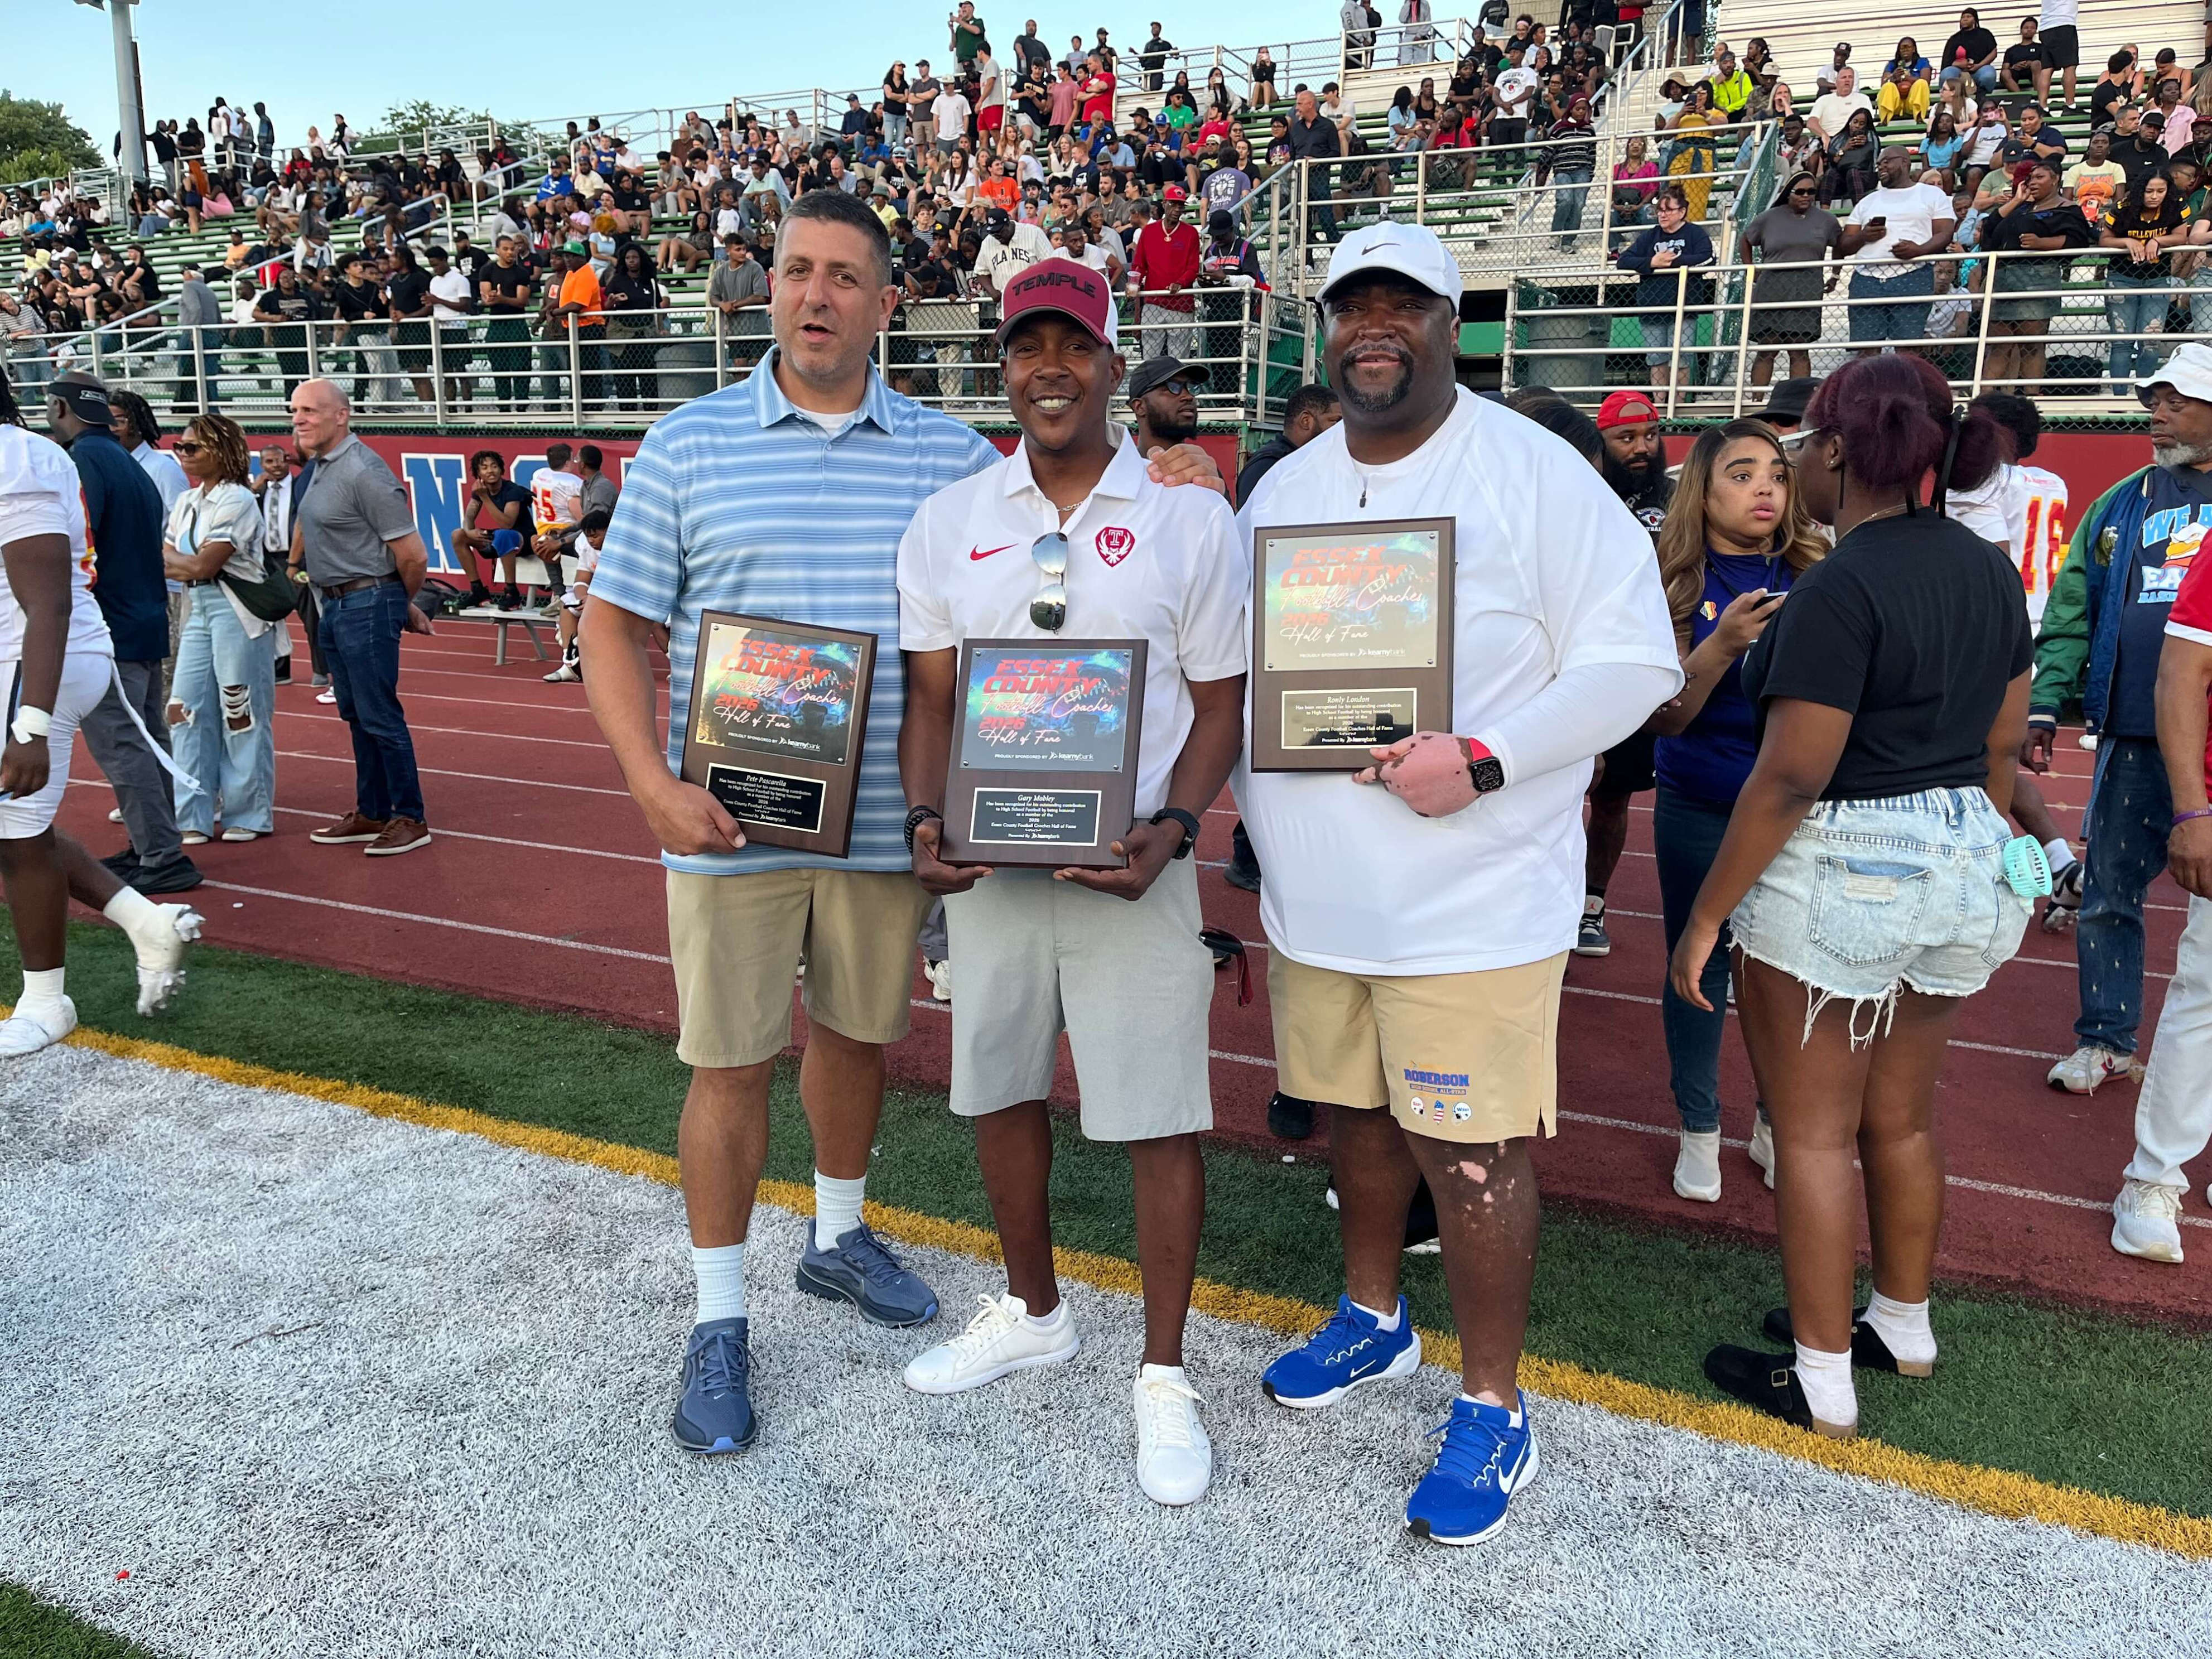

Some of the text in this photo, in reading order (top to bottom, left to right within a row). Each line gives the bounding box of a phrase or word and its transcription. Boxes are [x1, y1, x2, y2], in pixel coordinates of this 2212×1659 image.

[2128, 226, 2167, 238] BELLEVILLE
[1013, 272, 1096, 298] TEMPLE
[2142, 504, 2191, 549] WE
[1292, 546, 1387, 567] ESSEX
[1281, 564, 1407, 588] COUNTY
[1279, 578, 1423, 611] Football Coaches
[1281, 613, 1331, 626] 2026
[1280, 622, 1321, 646] Hall
[1325, 628, 1336, 643] of
[734, 638, 815, 665] ESSEX
[720, 654, 831, 684] COUNTY
[995, 659, 1085, 677] ESSEX
[716, 671, 841, 706] Football Coaches
[983, 676, 1101, 695] COUNTY
[715, 693, 759, 711] 2026
[980, 689, 1113, 718] Football Coaches
[713, 705, 749, 725] Hall
[752, 714, 763, 727] of
[979, 716, 1027, 730] 2026
[978, 726, 1016, 747] Hall
[1020, 731, 1031, 745] of
[759, 777, 787, 787] Pascarella
[1404, 1069, 1469, 1087] ROBERSON
